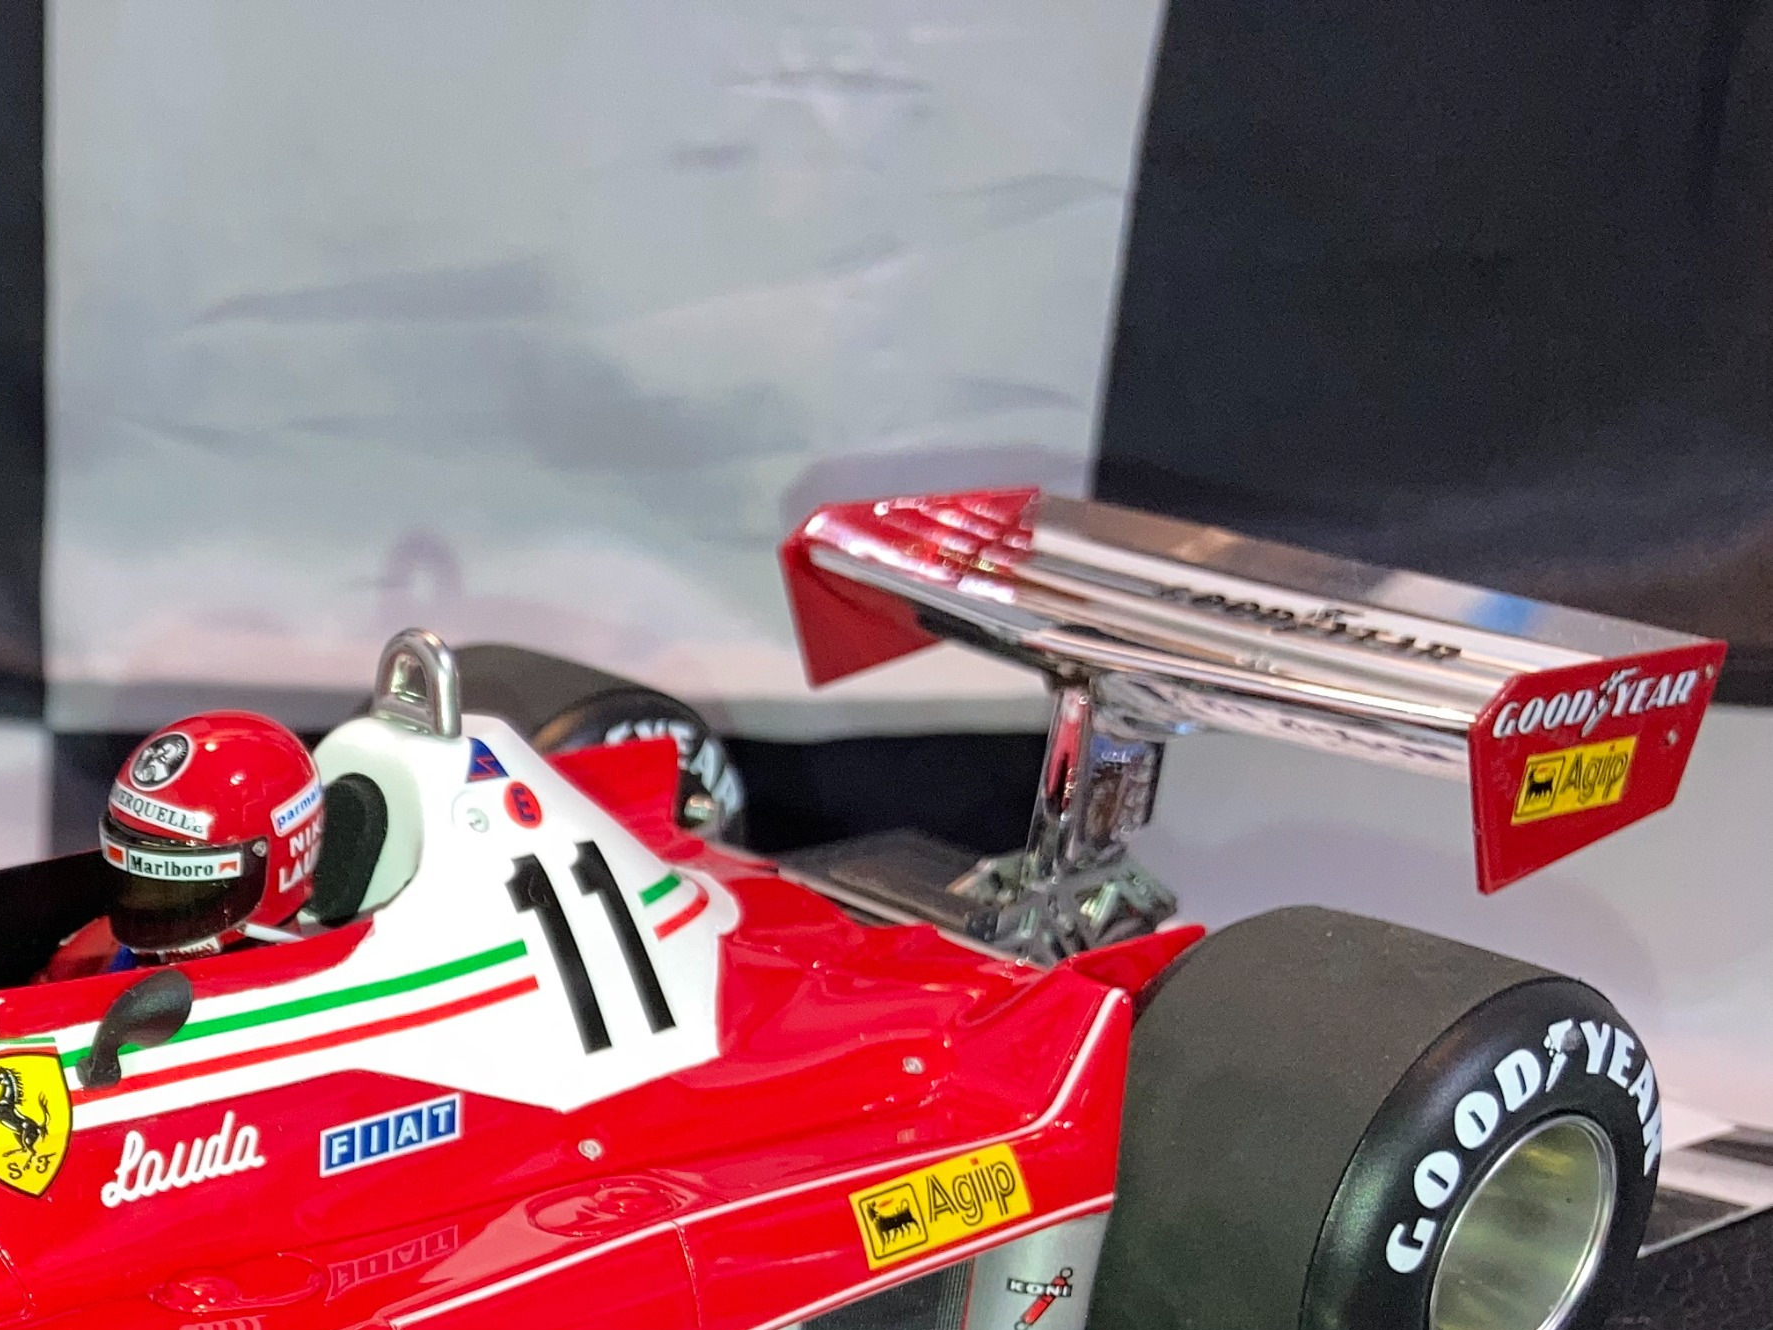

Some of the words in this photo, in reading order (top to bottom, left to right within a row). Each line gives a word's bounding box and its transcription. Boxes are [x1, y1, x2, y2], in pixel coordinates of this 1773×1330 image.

[1561, 744, 1629, 804] Agip
[130, 854, 214, 877] Marlboro
[506, 840, 677, 1055] 11
[101, 1110, 266, 1208] Lauda
[329, 1103, 453, 1167] FIAT
[7, 1162, 23, 1180] S
[925, 1158, 1015, 1226] Agip
[1010, 1279, 1070, 1297] KONI
